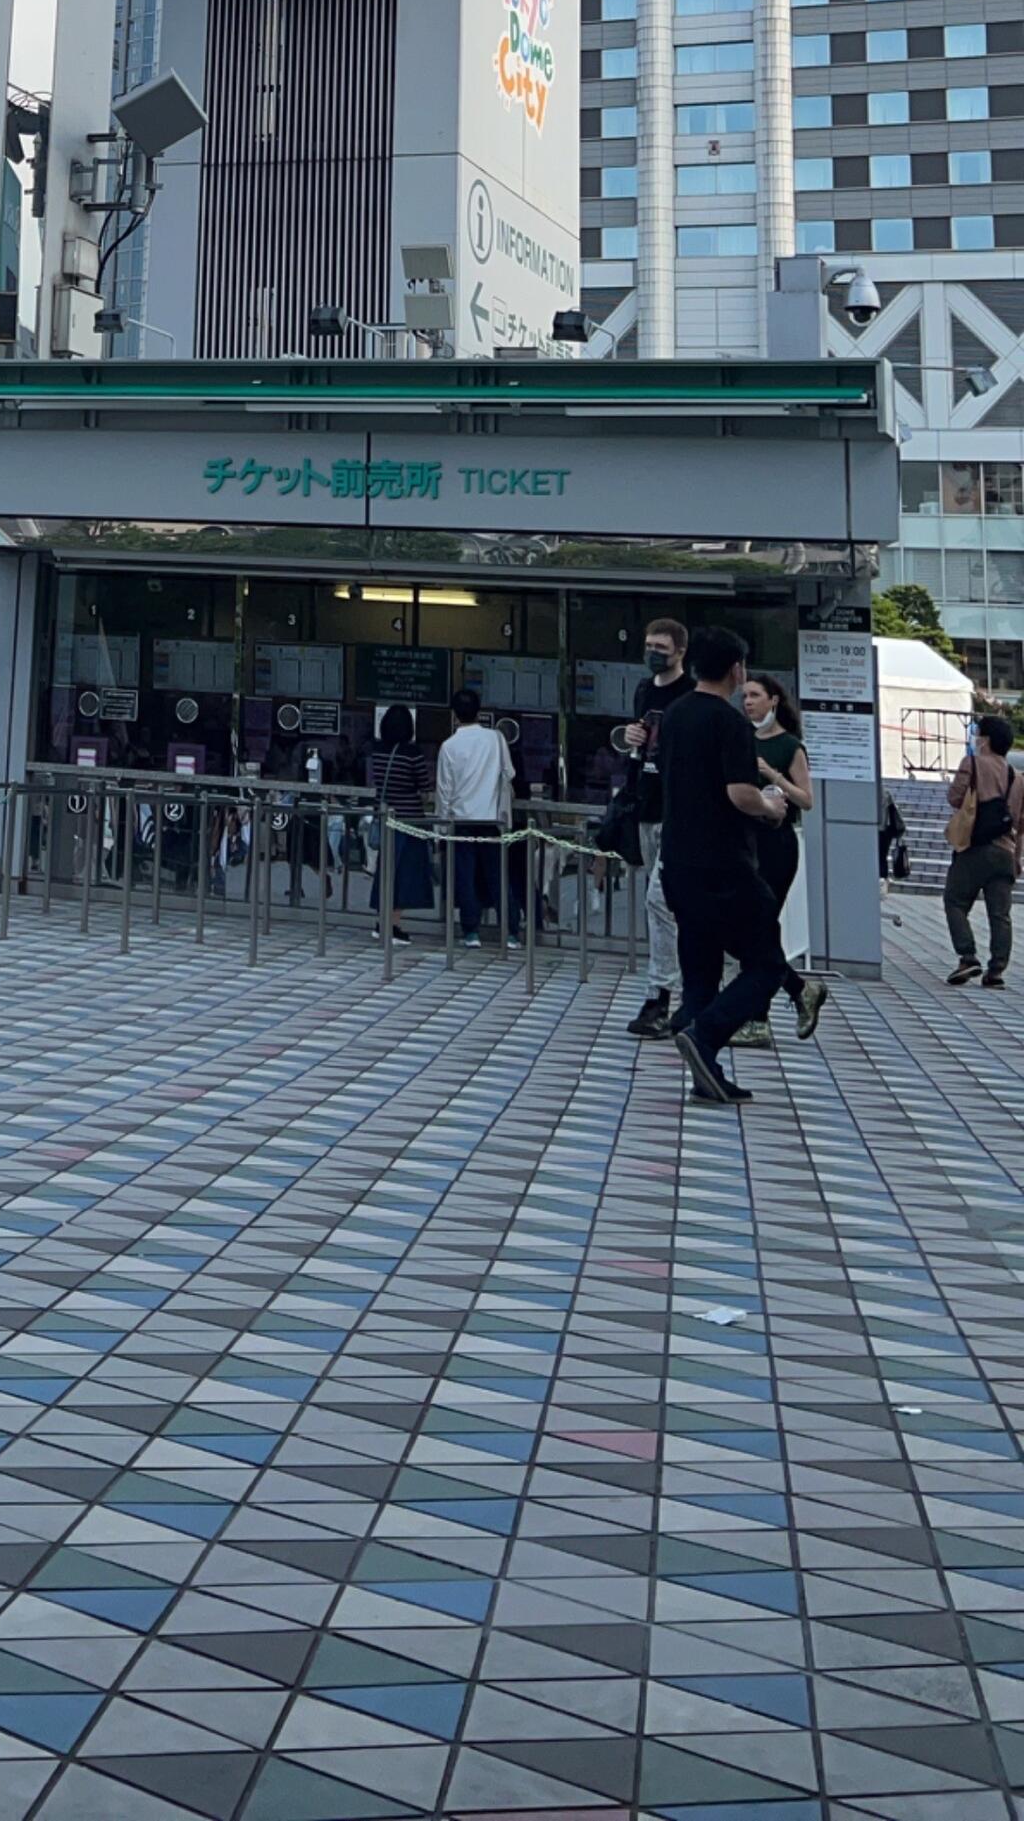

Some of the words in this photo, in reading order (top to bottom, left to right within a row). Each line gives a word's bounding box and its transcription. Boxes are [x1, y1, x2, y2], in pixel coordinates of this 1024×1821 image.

[510, 10, 553, 82] Dome
[499, 37, 548, 131] City
[496, 217, 575, 298] INFORMATION
[203, 457, 442, 500] チケット前売所
[458, 467, 572, 496] TICKET
[91, 604, 97, 615] 1
[187, 608, 196, 621] 2
[288, 614, 296, 625] 3
[394, 619, 402, 630] 4
[504, 624, 512, 636] 5
[618, 629, 627, 641] 6
